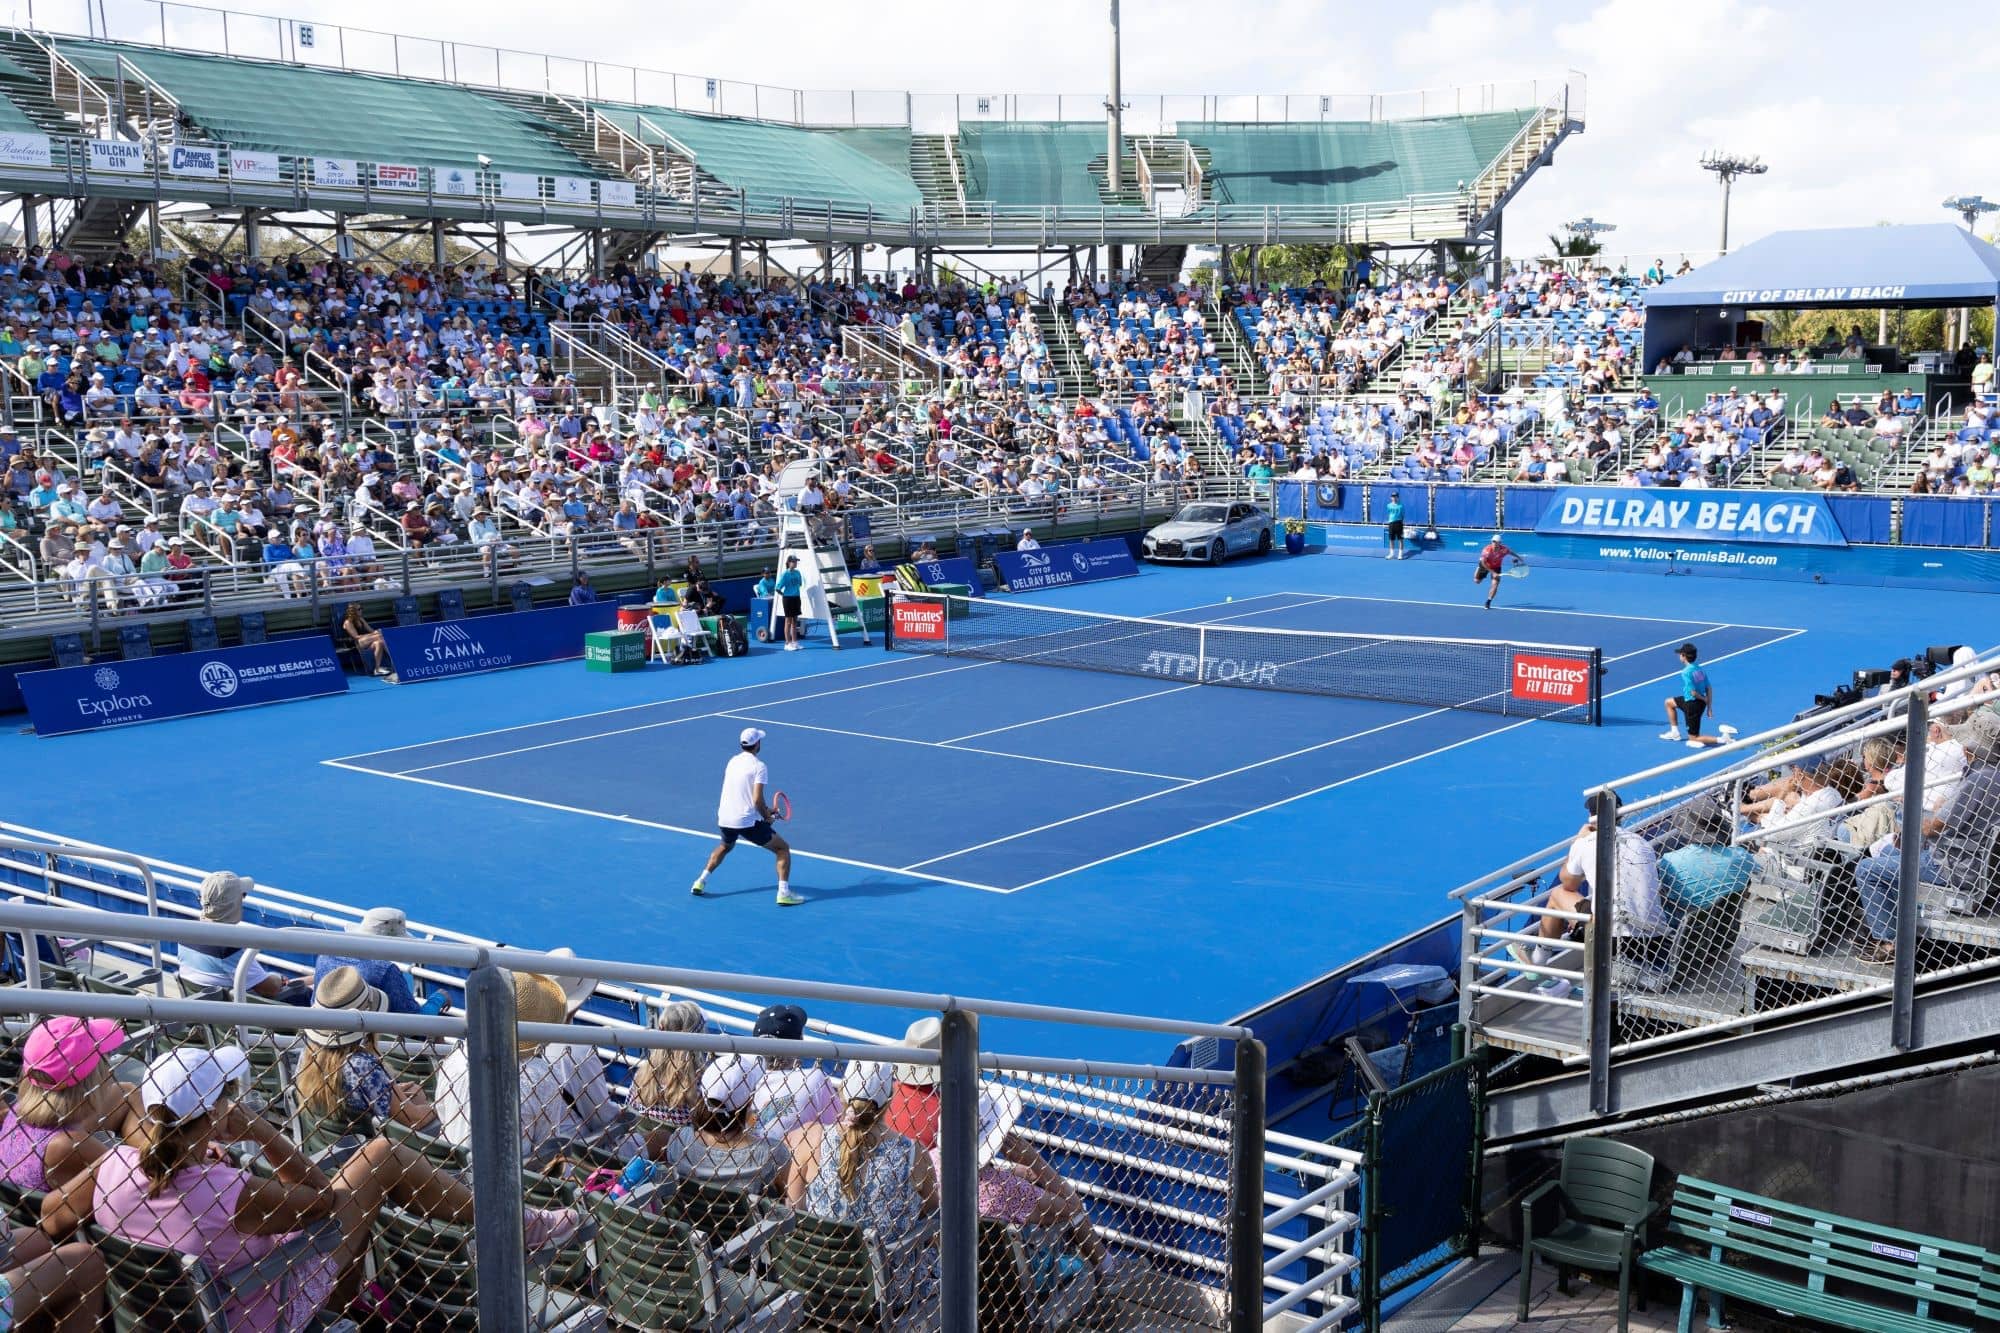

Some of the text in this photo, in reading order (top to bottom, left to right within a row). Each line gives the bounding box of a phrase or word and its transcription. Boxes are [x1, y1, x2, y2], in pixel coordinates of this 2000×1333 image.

[301, 27, 312, 45] EE
[707, 81, 715, 96] FF
[978, 99, 989, 113] HH
[92, 144, 139, 158] TULCHAN
[109, 156, 126, 168] GIN
[233, 159, 255, 170] VIP
[379, 165, 417, 180] ESPN
[378, 180, 417, 189] WEST PALM
[1566, 260, 1576, 276] N
[1343, 270, 1355, 286] M
[1722, 286, 1906, 304] CITY OF DELRAY BEACH
[1560, 498, 1817, 534] DELRAY BEACH
[1029, 566, 1051, 575] CITY OF
[1012, 571, 1073, 589] DELRAY BEACH
[896, 608, 942, 623] Emirates
[904, 622, 936, 633] FLY BETTER
[424, 641, 485, 661] STAMM
[239, 657, 335, 678] DELRAY BEACH CRA
[406, 654, 513, 678] DEVELOPMENT GROUP
[1139, 650, 1279, 685] ATP TOUR
[1516, 662, 1585, 683] Emirates
[1526, 680, 1574, 696] FLY BETTER
[77, 694, 152, 717] Explora
[102, 714, 143, 725] JOURNEYS
